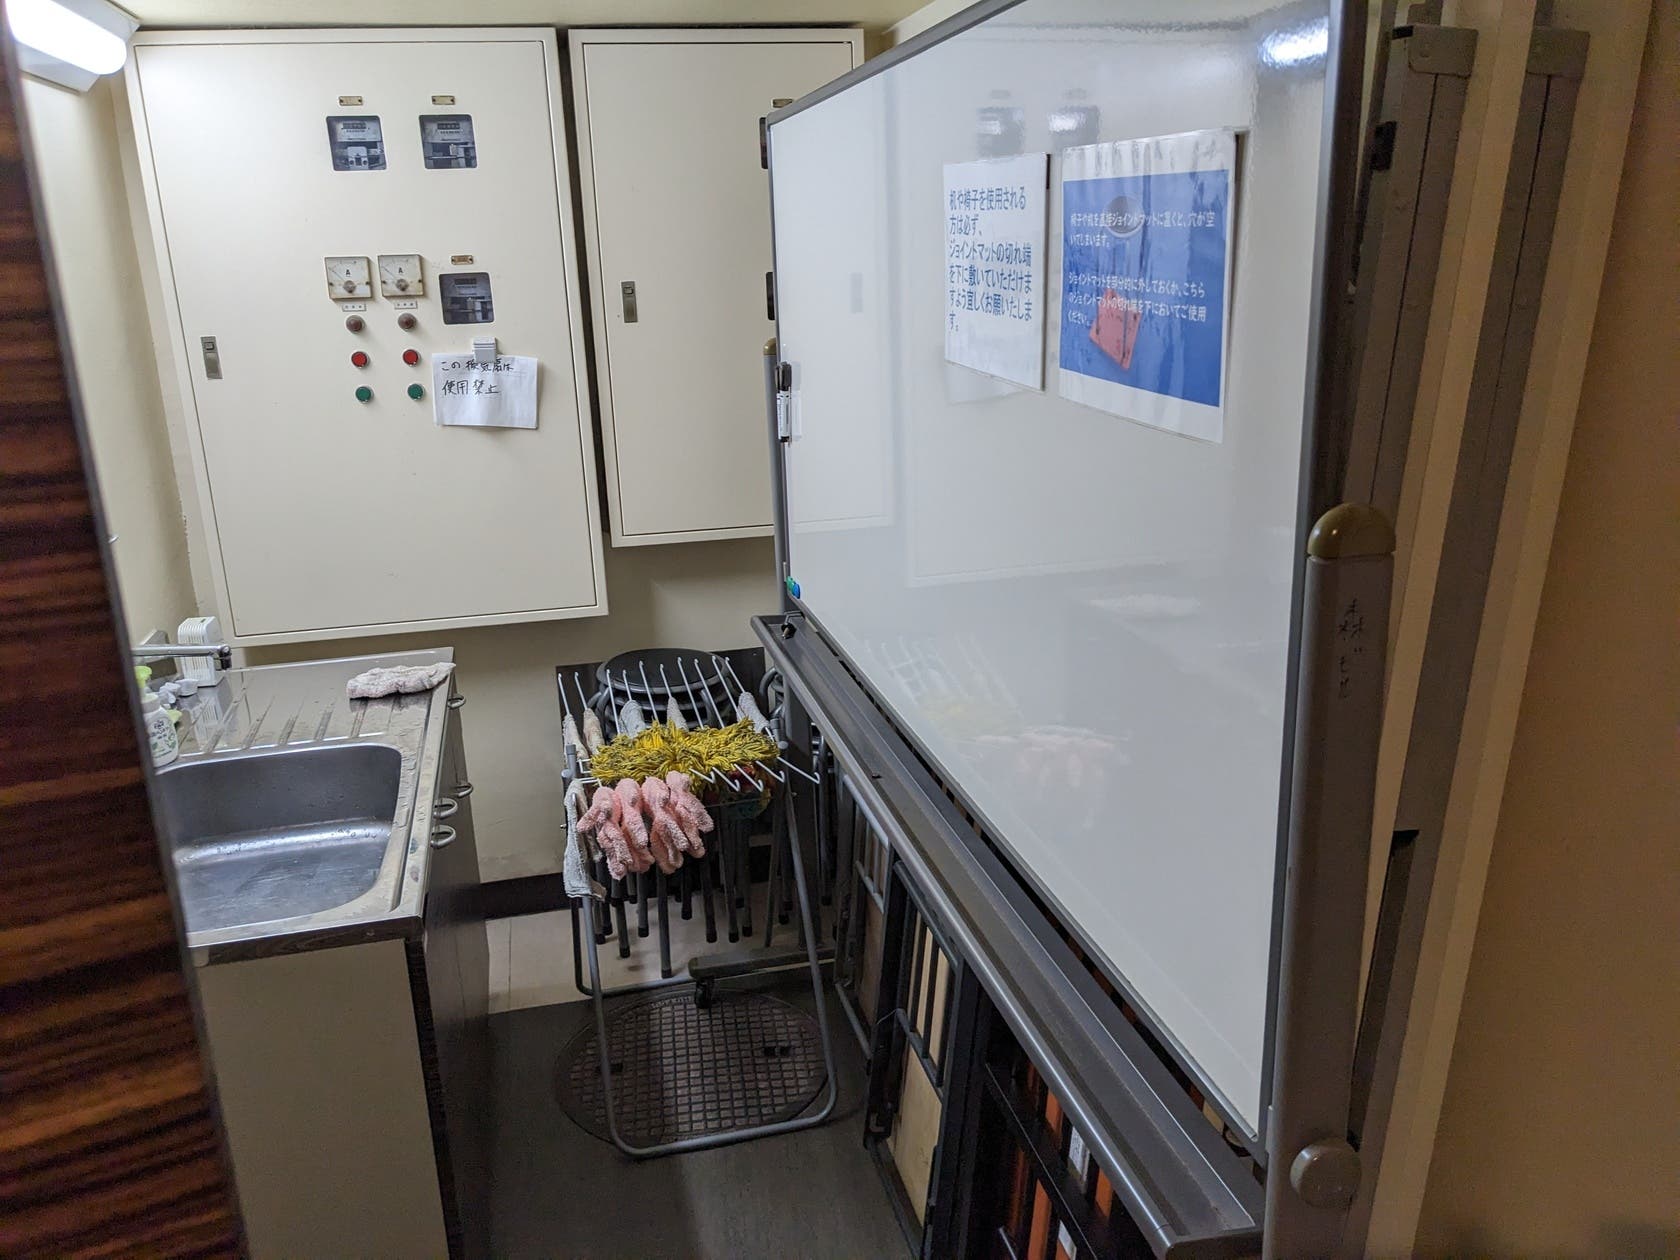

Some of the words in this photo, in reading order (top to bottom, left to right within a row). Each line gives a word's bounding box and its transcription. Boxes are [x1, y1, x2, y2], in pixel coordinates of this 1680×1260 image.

[949, 186, 1026, 211] 机や椅子を使用される
[949, 213, 983, 236] 方は必ず、
[949, 239, 1032, 267] ジョイントマットの切れ端
[949, 264, 1032, 294] を下に敷いていただけま
[949, 287, 1032, 322] すよう宜しくお願いたしま
[949, 310, 960, 332] す。
